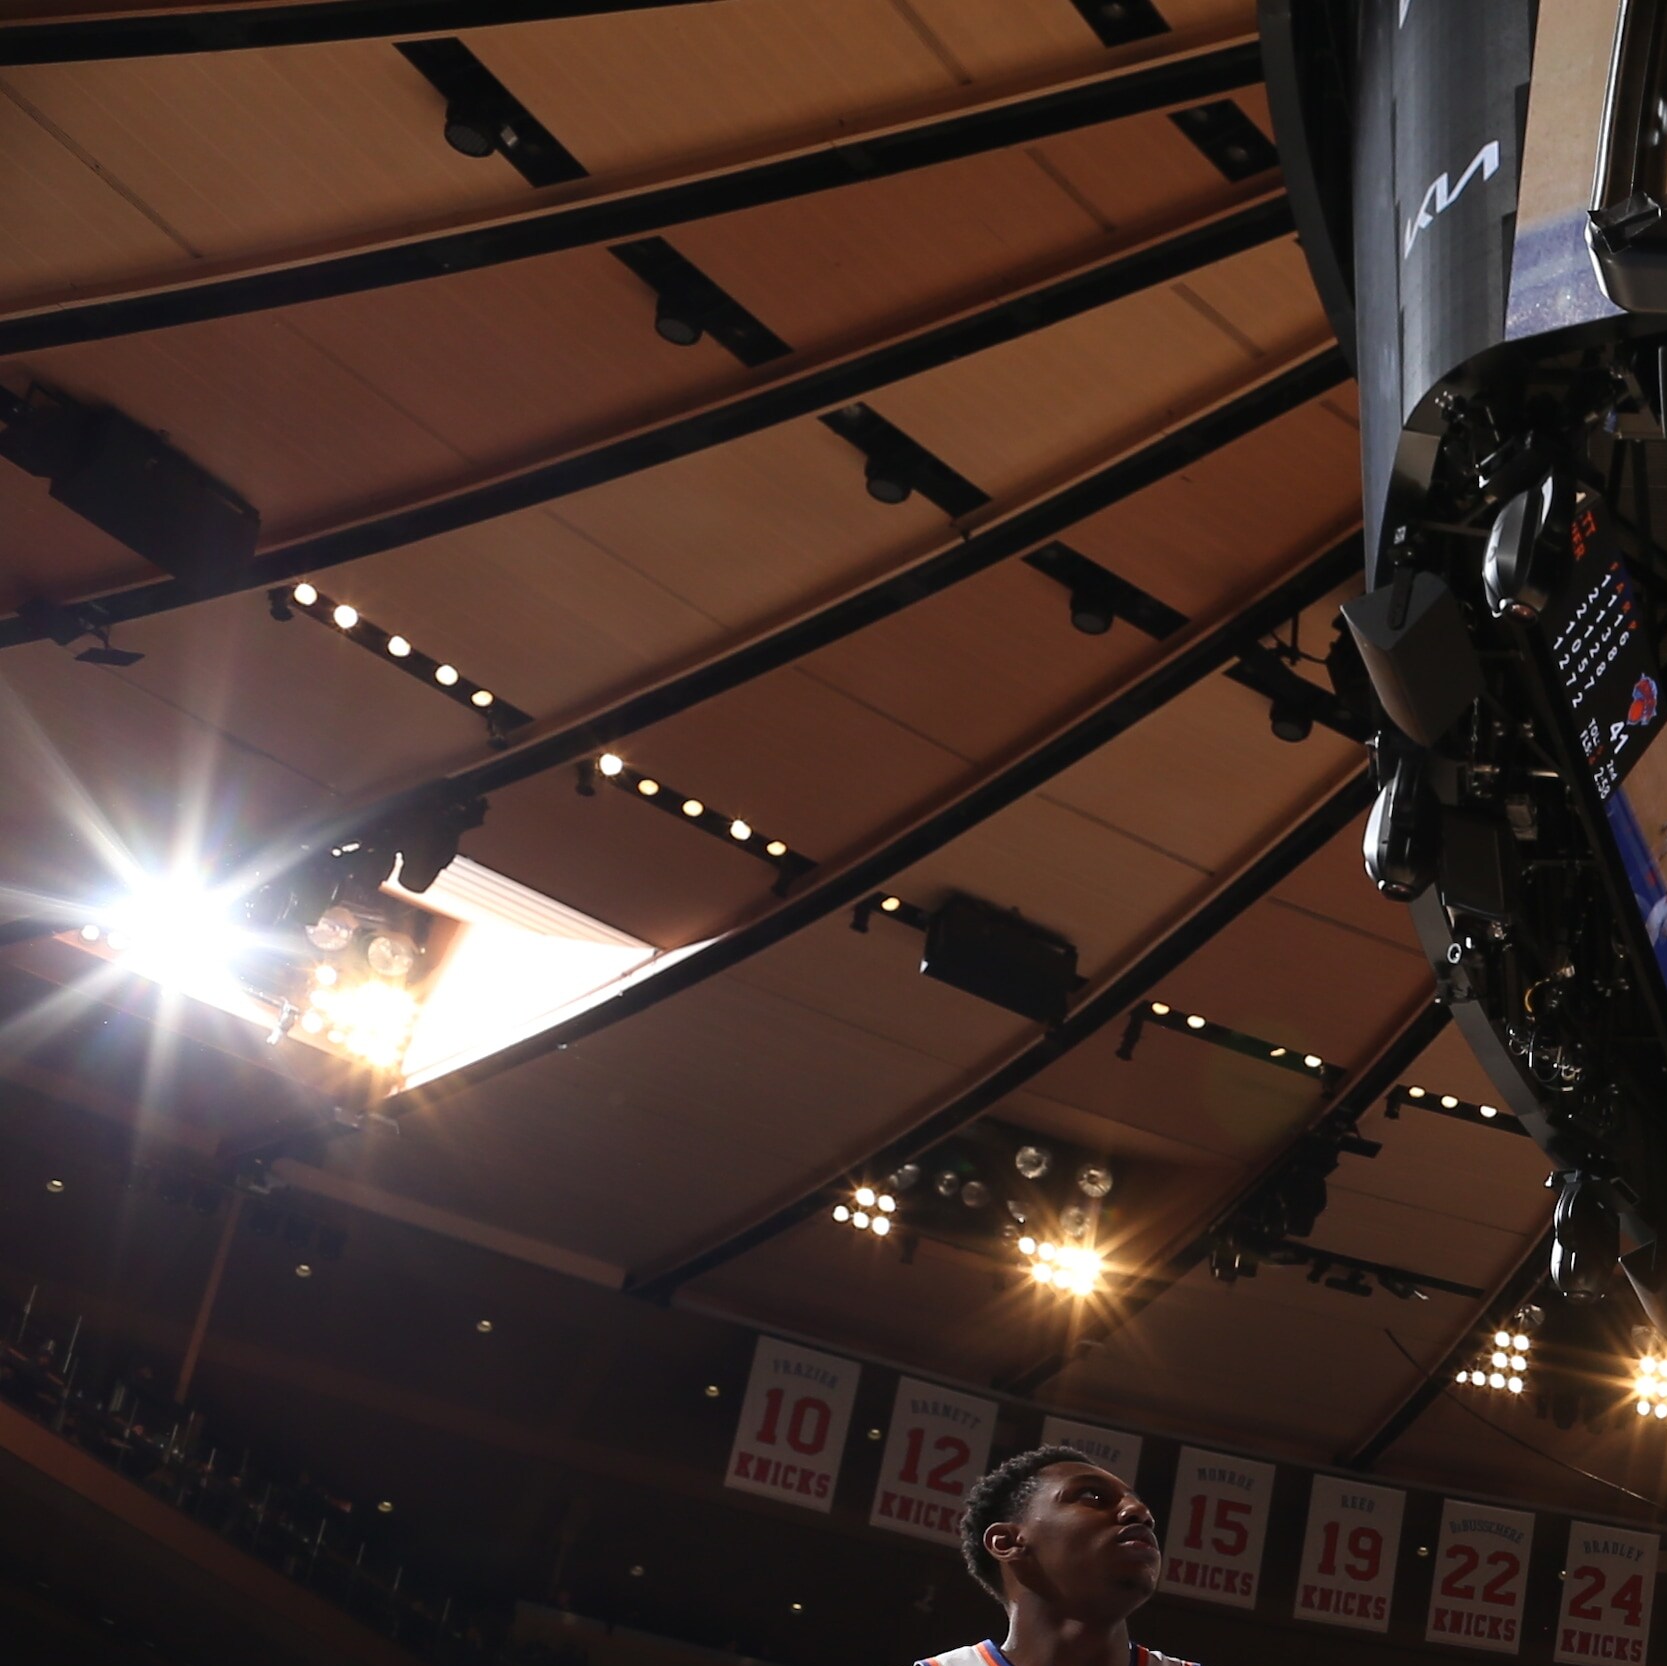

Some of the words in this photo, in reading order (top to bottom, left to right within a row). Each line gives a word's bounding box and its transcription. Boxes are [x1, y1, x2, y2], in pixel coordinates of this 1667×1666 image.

[773, 1359, 839, 1389] FRAZIER
[756, 1388, 831, 1455] 10
[735, 1451, 831, 1498] KNICKS
[898, 1427, 970, 1496] 12
[1198, 1467, 1255, 1489] MONROE
[1184, 1494, 1252, 1557] 15
[1318, 1521, 1383, 1582] 19
[1583, 1540, 1644, 1562] BRADLEY
[1166, 1558, 1254, 1597] KNICKS
[1441, 1544, 1520, 1607] 22
[1568, 1565, 1643, 1627] 24
[1301, 1584, 1386, 1621] KNICKS
[1433, 1608, 1516, 1642] KNICKS
[1560, 1628, 1643, 1663] KNICKS
